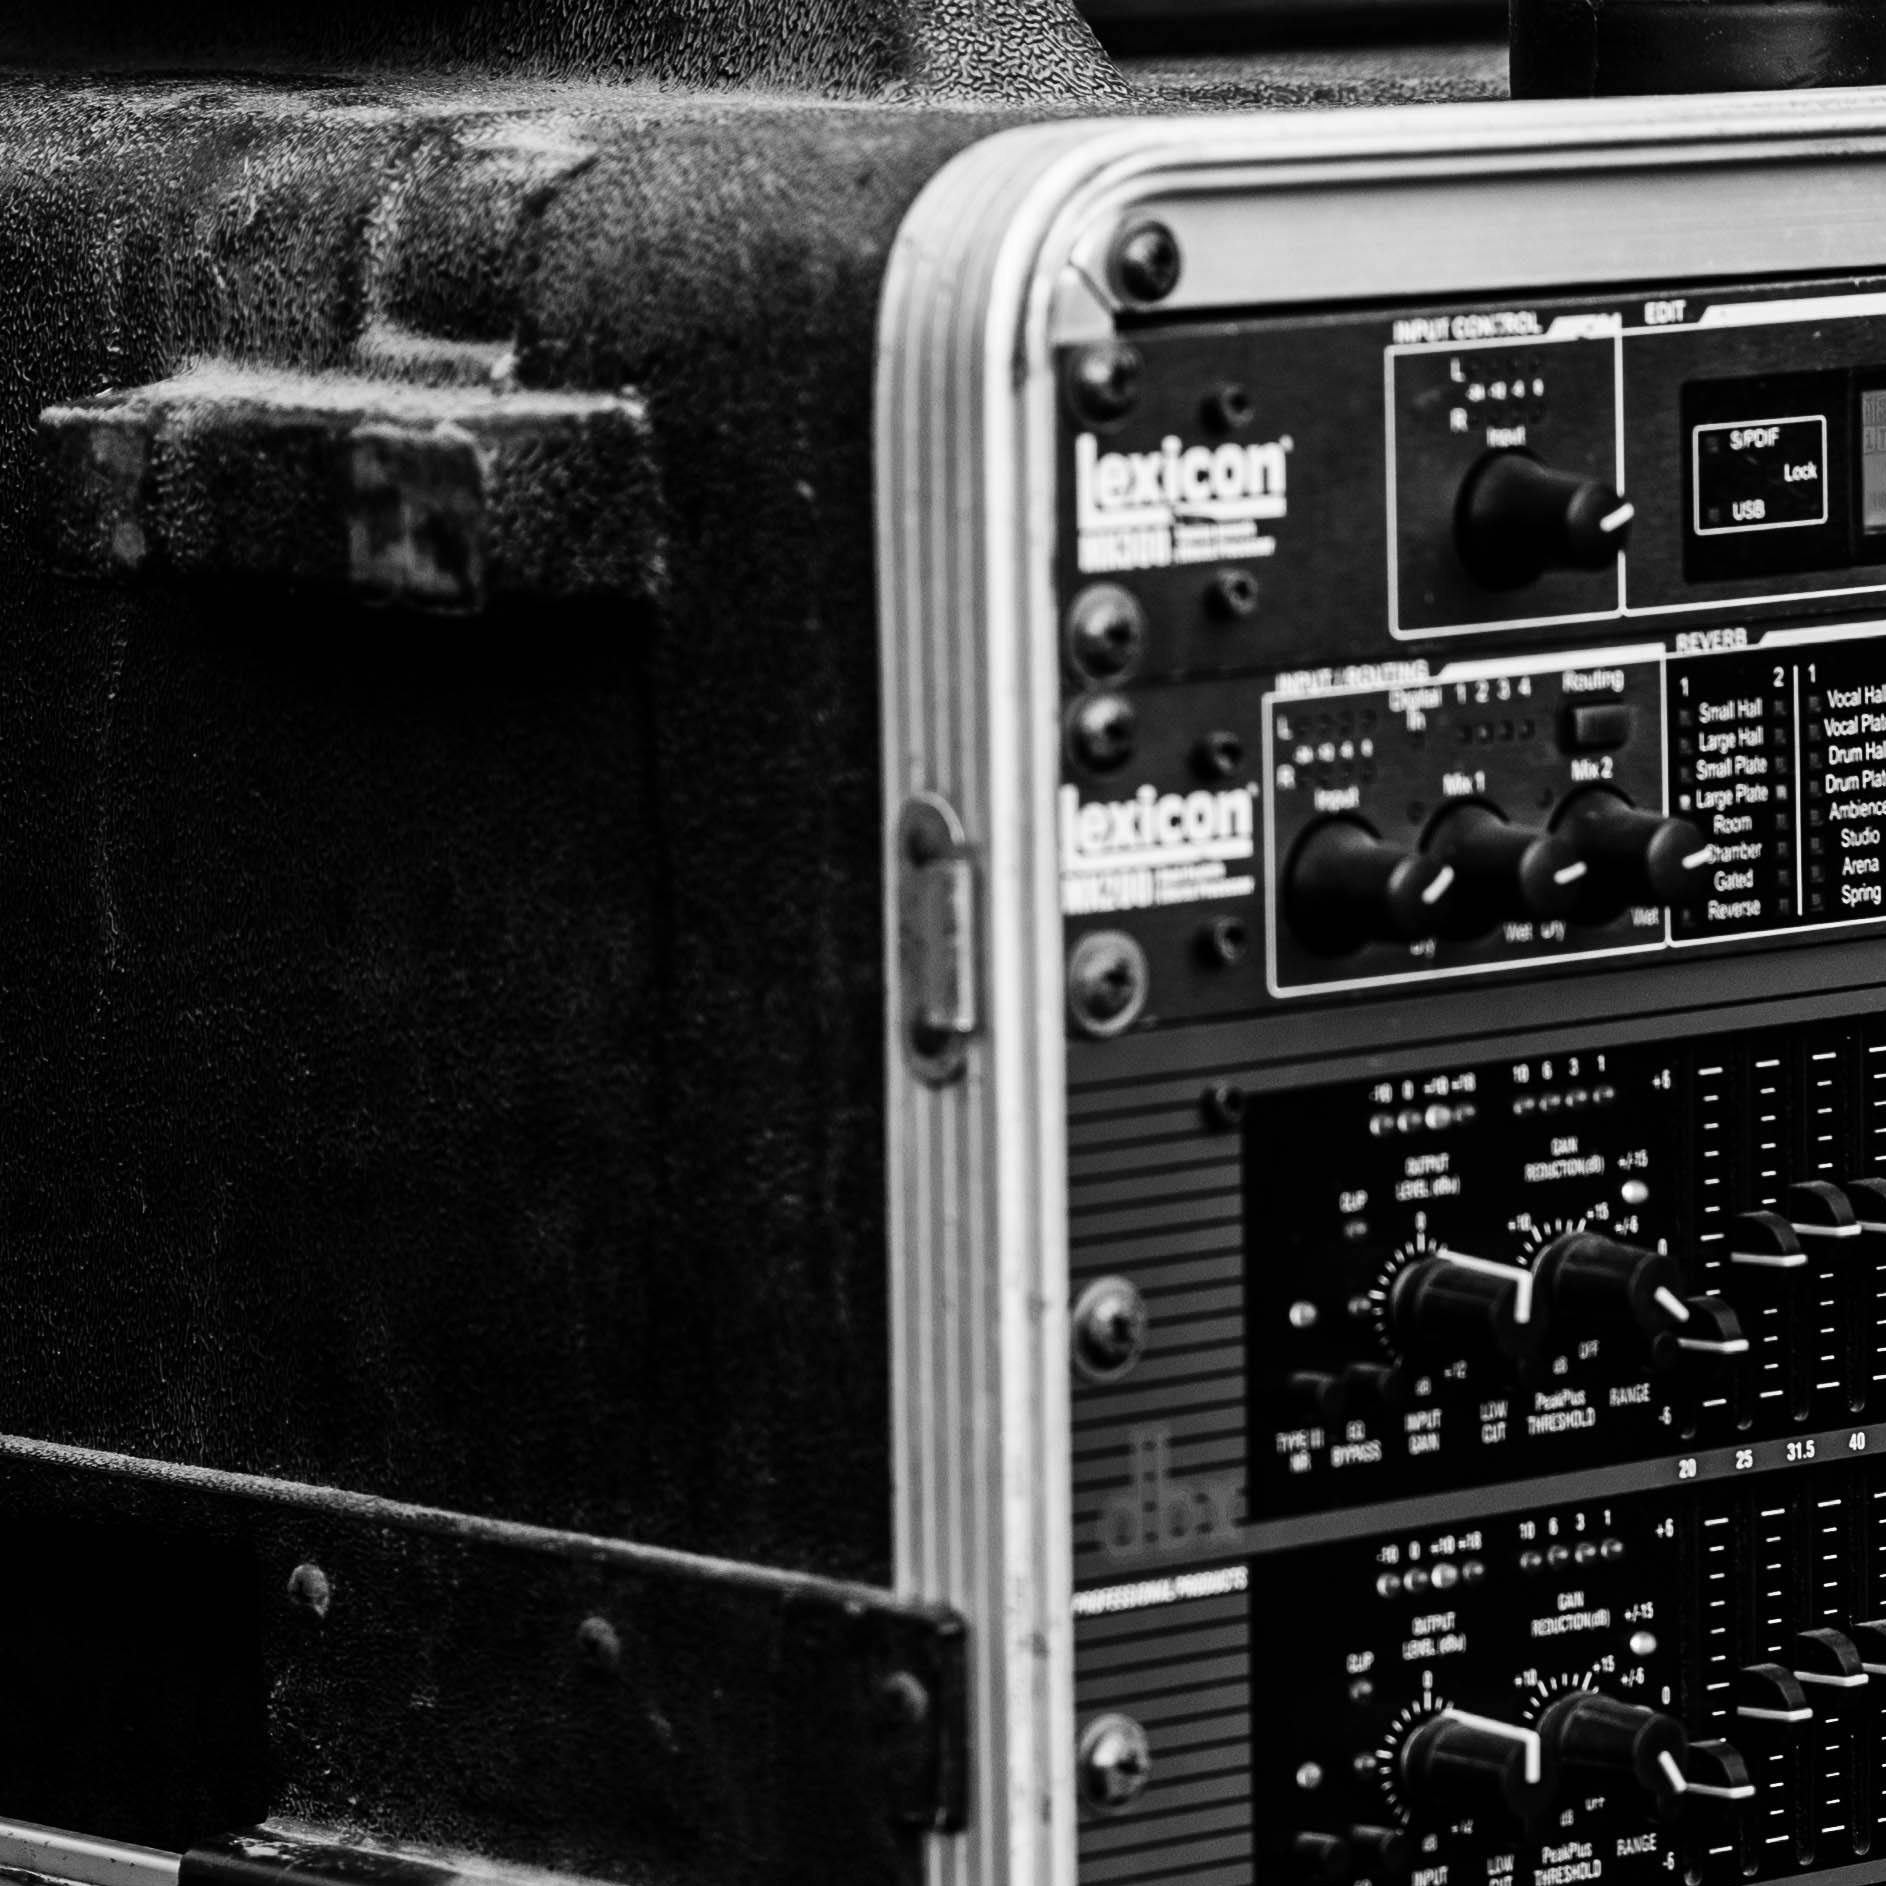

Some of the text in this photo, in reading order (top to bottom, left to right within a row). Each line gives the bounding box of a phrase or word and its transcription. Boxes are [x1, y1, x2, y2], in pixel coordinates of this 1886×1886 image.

[1645, 300, 1686, 325] EDIT
[1784, 462, 1817, 482] Lock
[1733, 499, 1765, 520] USB
[1675, 627, 1749, 653] REVERB
[1827, 687, 1861, 708] Vocal
[1699, 698, 1762, 723] Small Hall
[1824, 716, 1858, 737] Vocal
[1699, 726, 1763, 754] Large Hall
[1829, 745, 1862, 765] Drum
[1696, 755, 1767, 780] Small Plate
[1825, 774, 1859, 793] Drum
[1696, 784, 1768, 811] Large Plate
[1714, 814, 1752, 833] Room
[1841, 827, 1880, 847] Studio
[1842, 857, 1879, 875] Arena
[1841, 885, 1881, 907] Spring
[1708, 900, 1761, 919] Reverse
[1679, 1459, 1696, 1478] 20
[1736, 1449, 1753, 1469] 25
[1787, 1440, 1815, 1461] 31.5
[1849, 1432, 1865, 1450] 40
